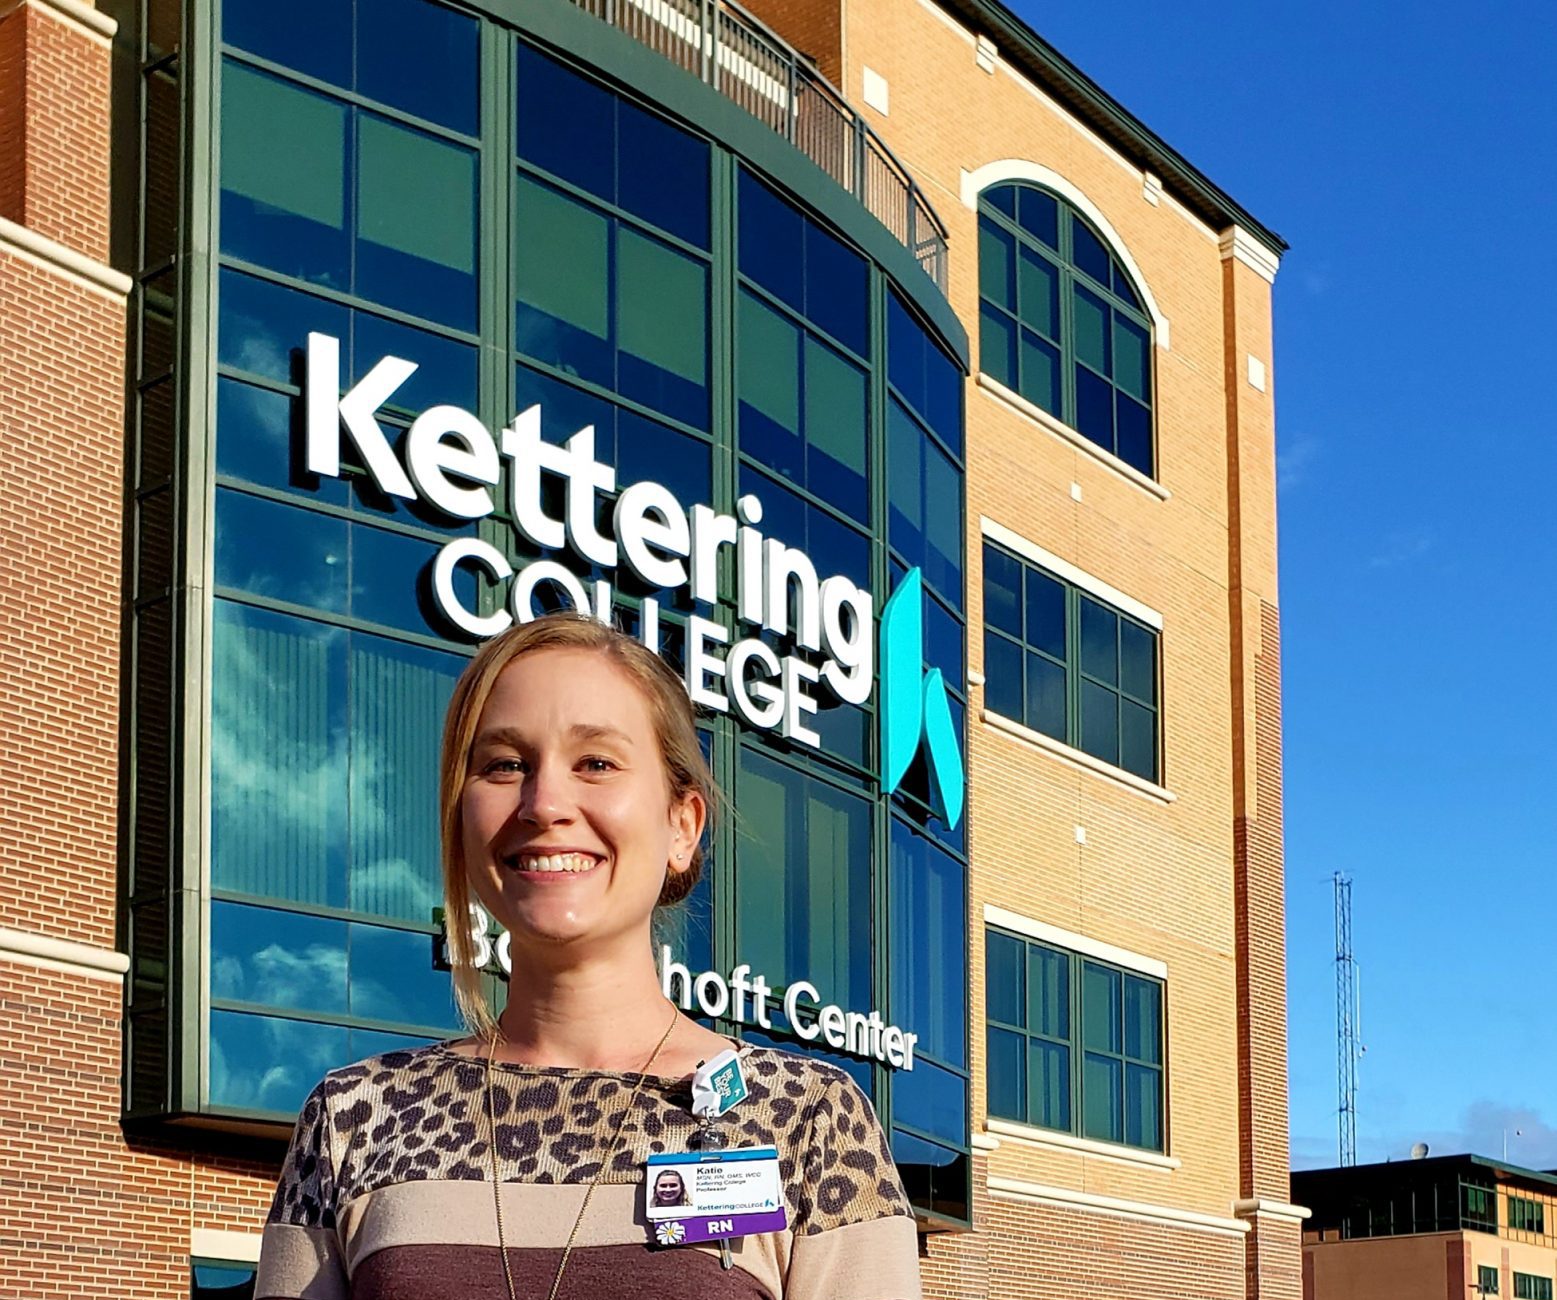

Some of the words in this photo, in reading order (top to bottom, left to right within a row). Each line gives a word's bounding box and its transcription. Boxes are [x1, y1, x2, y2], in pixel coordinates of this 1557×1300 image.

[306, 331, 873, 706] Kettering
[784, 981, 917, 1071] Center
[696, 1167, 723, 1175] Katie
[707, 1219, 734, 1234] RN
